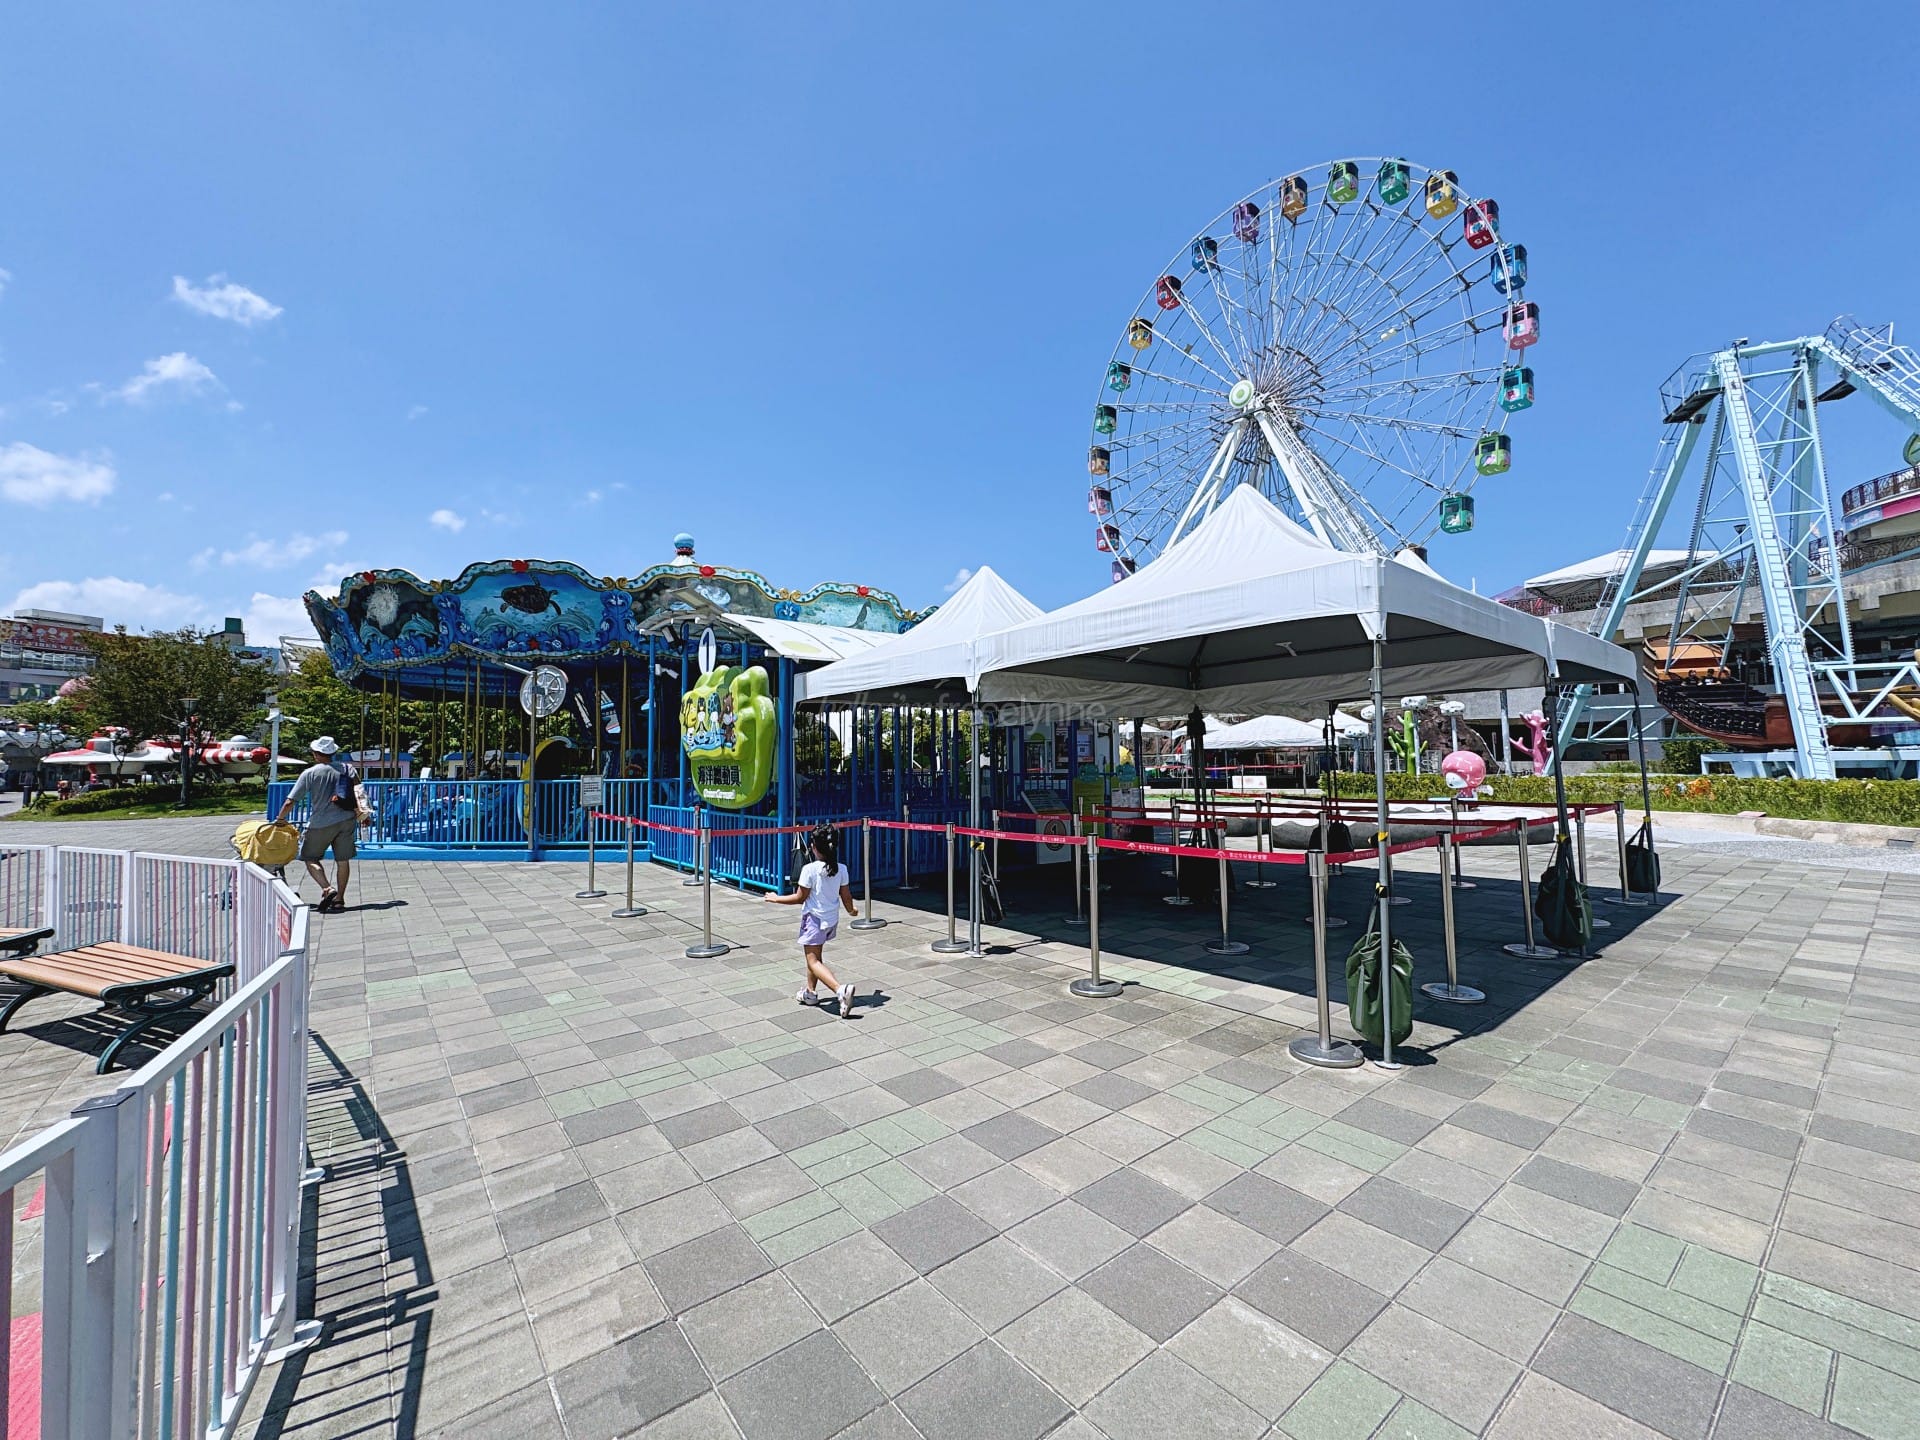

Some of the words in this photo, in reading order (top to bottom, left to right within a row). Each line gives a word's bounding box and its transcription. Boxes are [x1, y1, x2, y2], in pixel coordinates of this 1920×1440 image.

[1389, 191, 1401, 201] 17
[1435, 206, 1449, 214] 16
[1474, 235, 1490, 244] 15
[702, 631, 710, 673] 1
